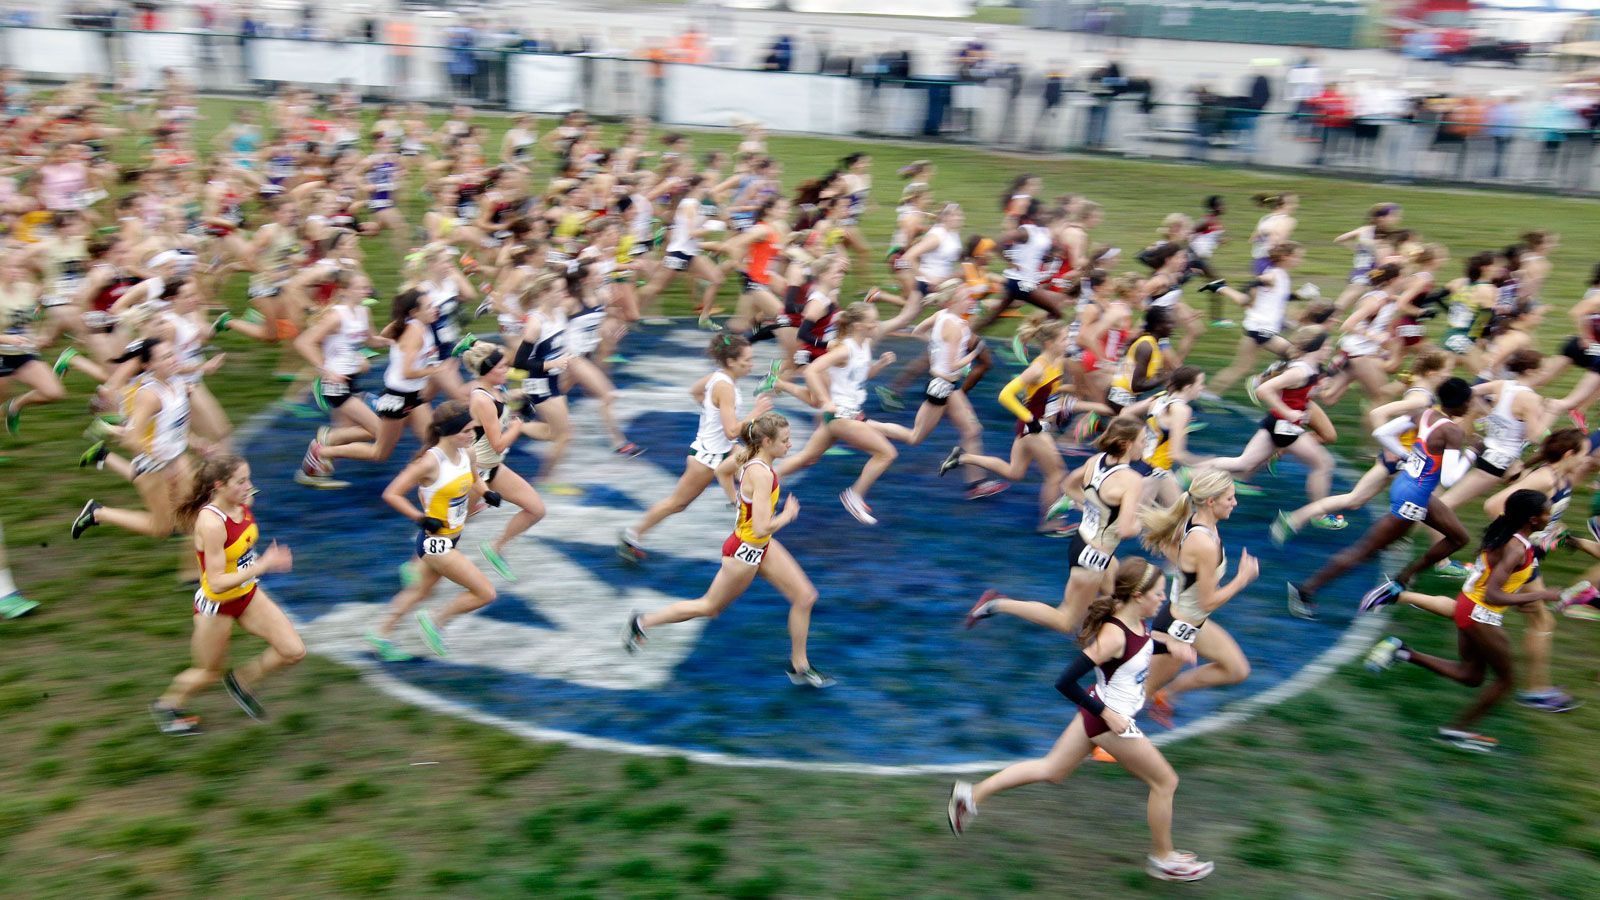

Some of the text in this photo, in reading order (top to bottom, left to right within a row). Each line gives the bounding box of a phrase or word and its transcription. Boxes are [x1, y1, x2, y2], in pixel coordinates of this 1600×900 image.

[430, 538, 446, 554] 83
[737, 545, 762, 564] 267
[1175, 623, 1196, 641] 98
